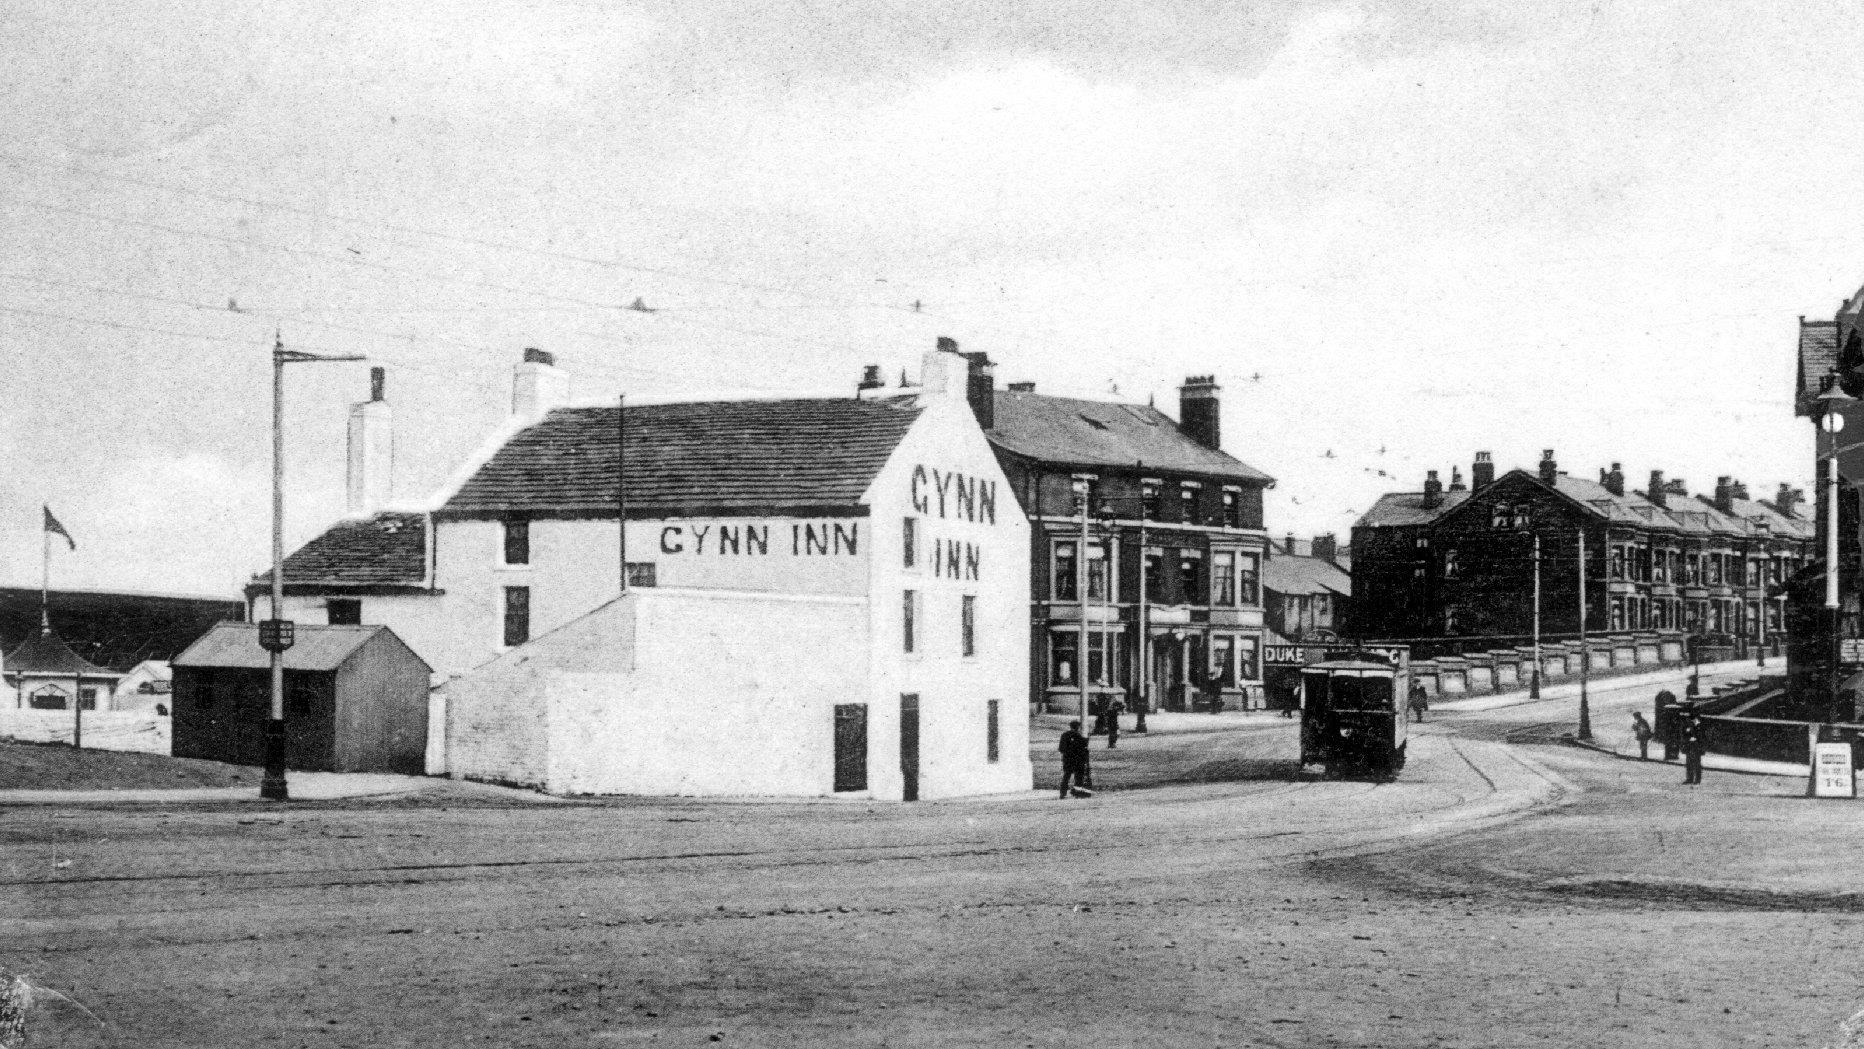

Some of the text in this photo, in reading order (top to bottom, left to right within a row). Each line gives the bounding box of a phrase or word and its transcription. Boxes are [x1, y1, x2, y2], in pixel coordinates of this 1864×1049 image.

[911, 463, 996, 526] GYNN
[660, 523, 857, 556] GYNN INN
[936, 537, 979, 580] INN
[1264, 647, 1304, 662] DUKE
